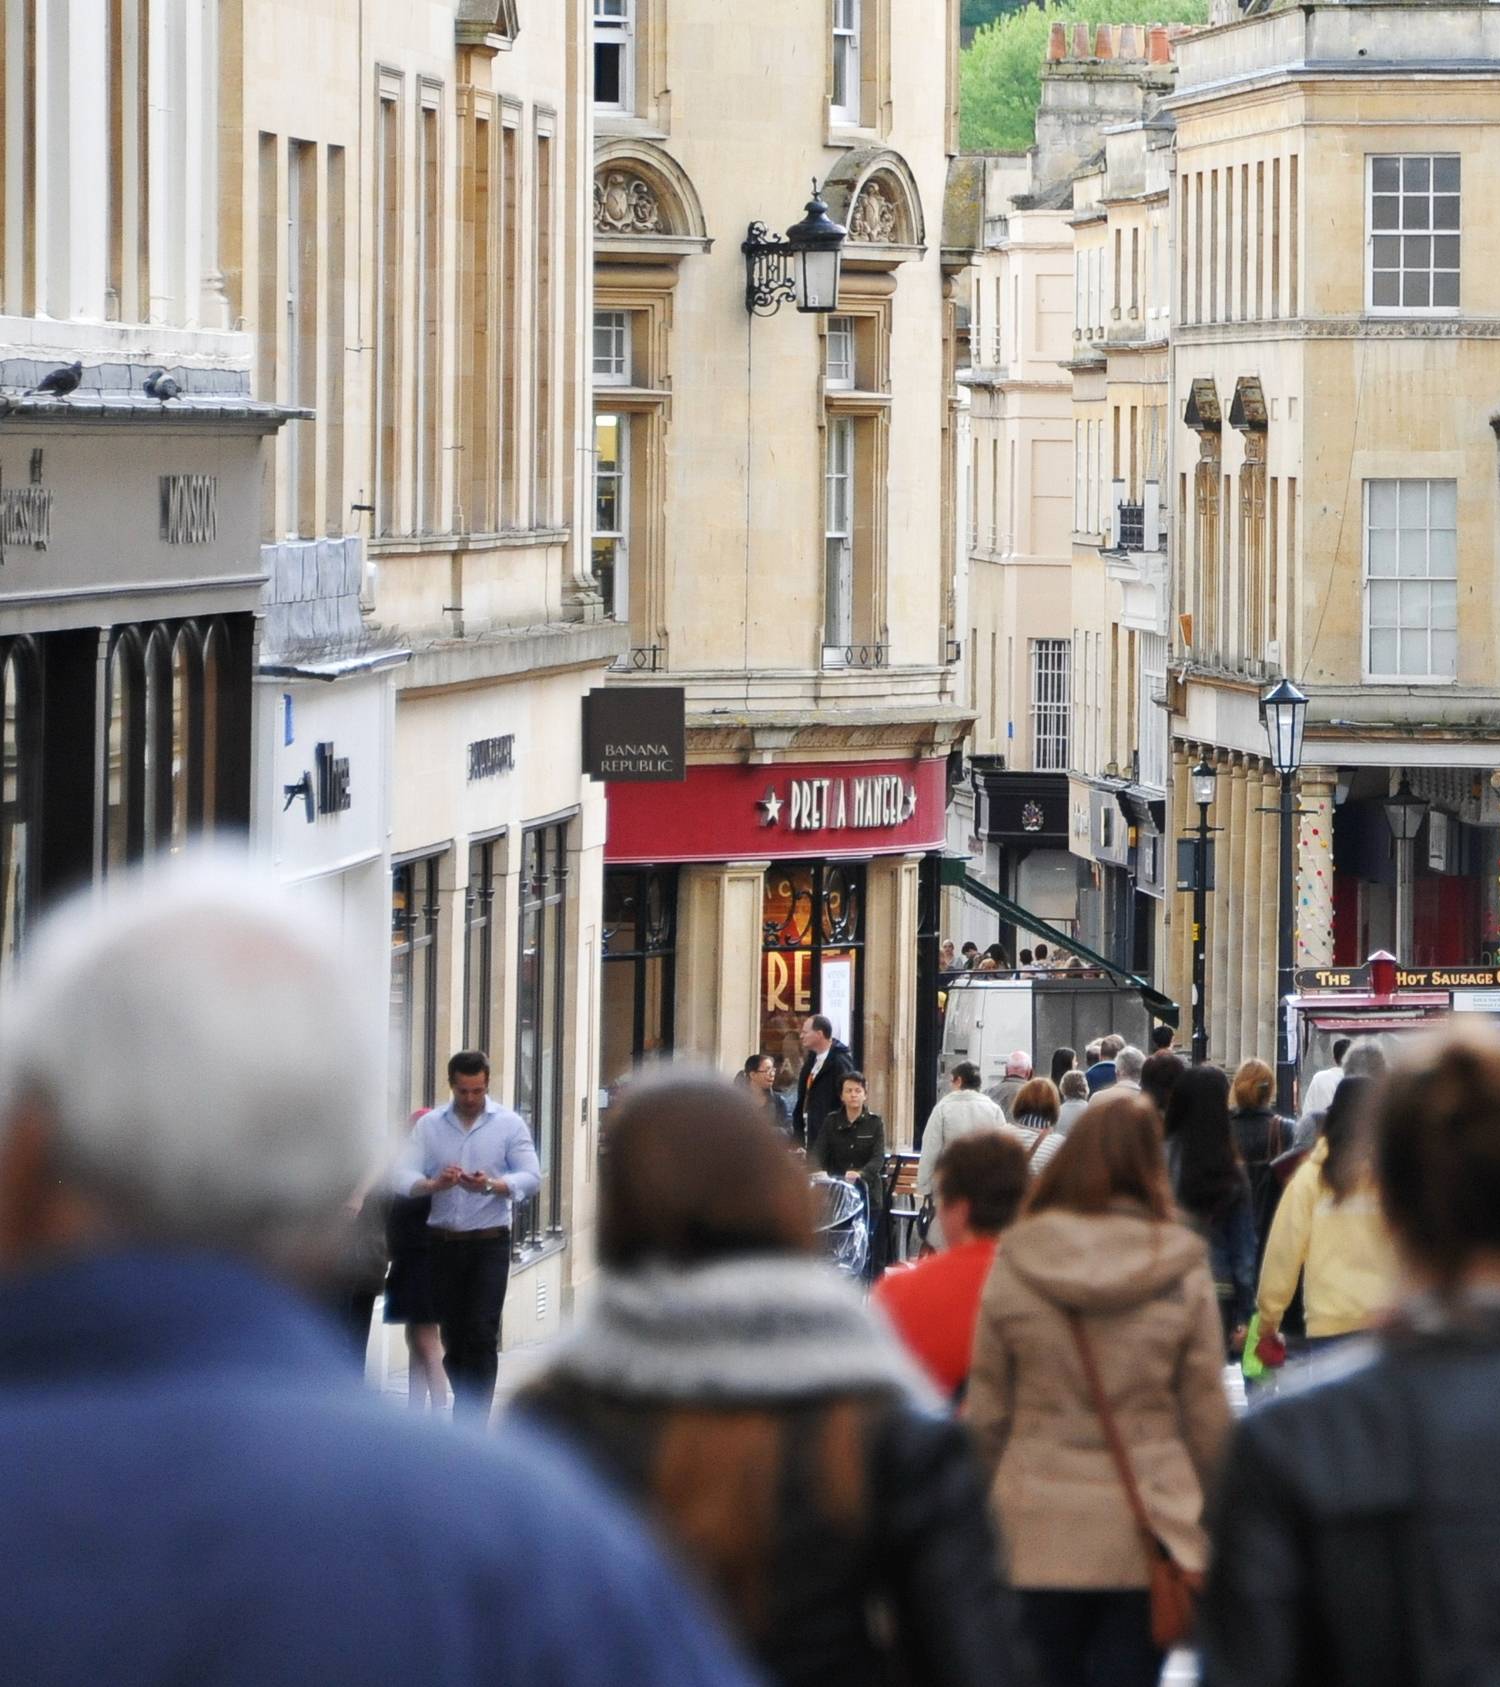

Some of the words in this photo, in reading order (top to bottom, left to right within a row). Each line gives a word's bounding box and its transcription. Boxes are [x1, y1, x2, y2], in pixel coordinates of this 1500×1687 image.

[165, 474, 217, 545] MONSOON
[605, 744, 669, 757] BANANA
[601, 760, 673, 773] REPUBLIC
[790, 778, 831, 831] PRET
[836, 779, 847, 829] A
[853, 775, 904, 829] MANGER
[1316, 971, 1350, 986] THE
[1396, 972, 1427, 986] HOT
[1432, 971, 1493, 985] SAUSAGE
